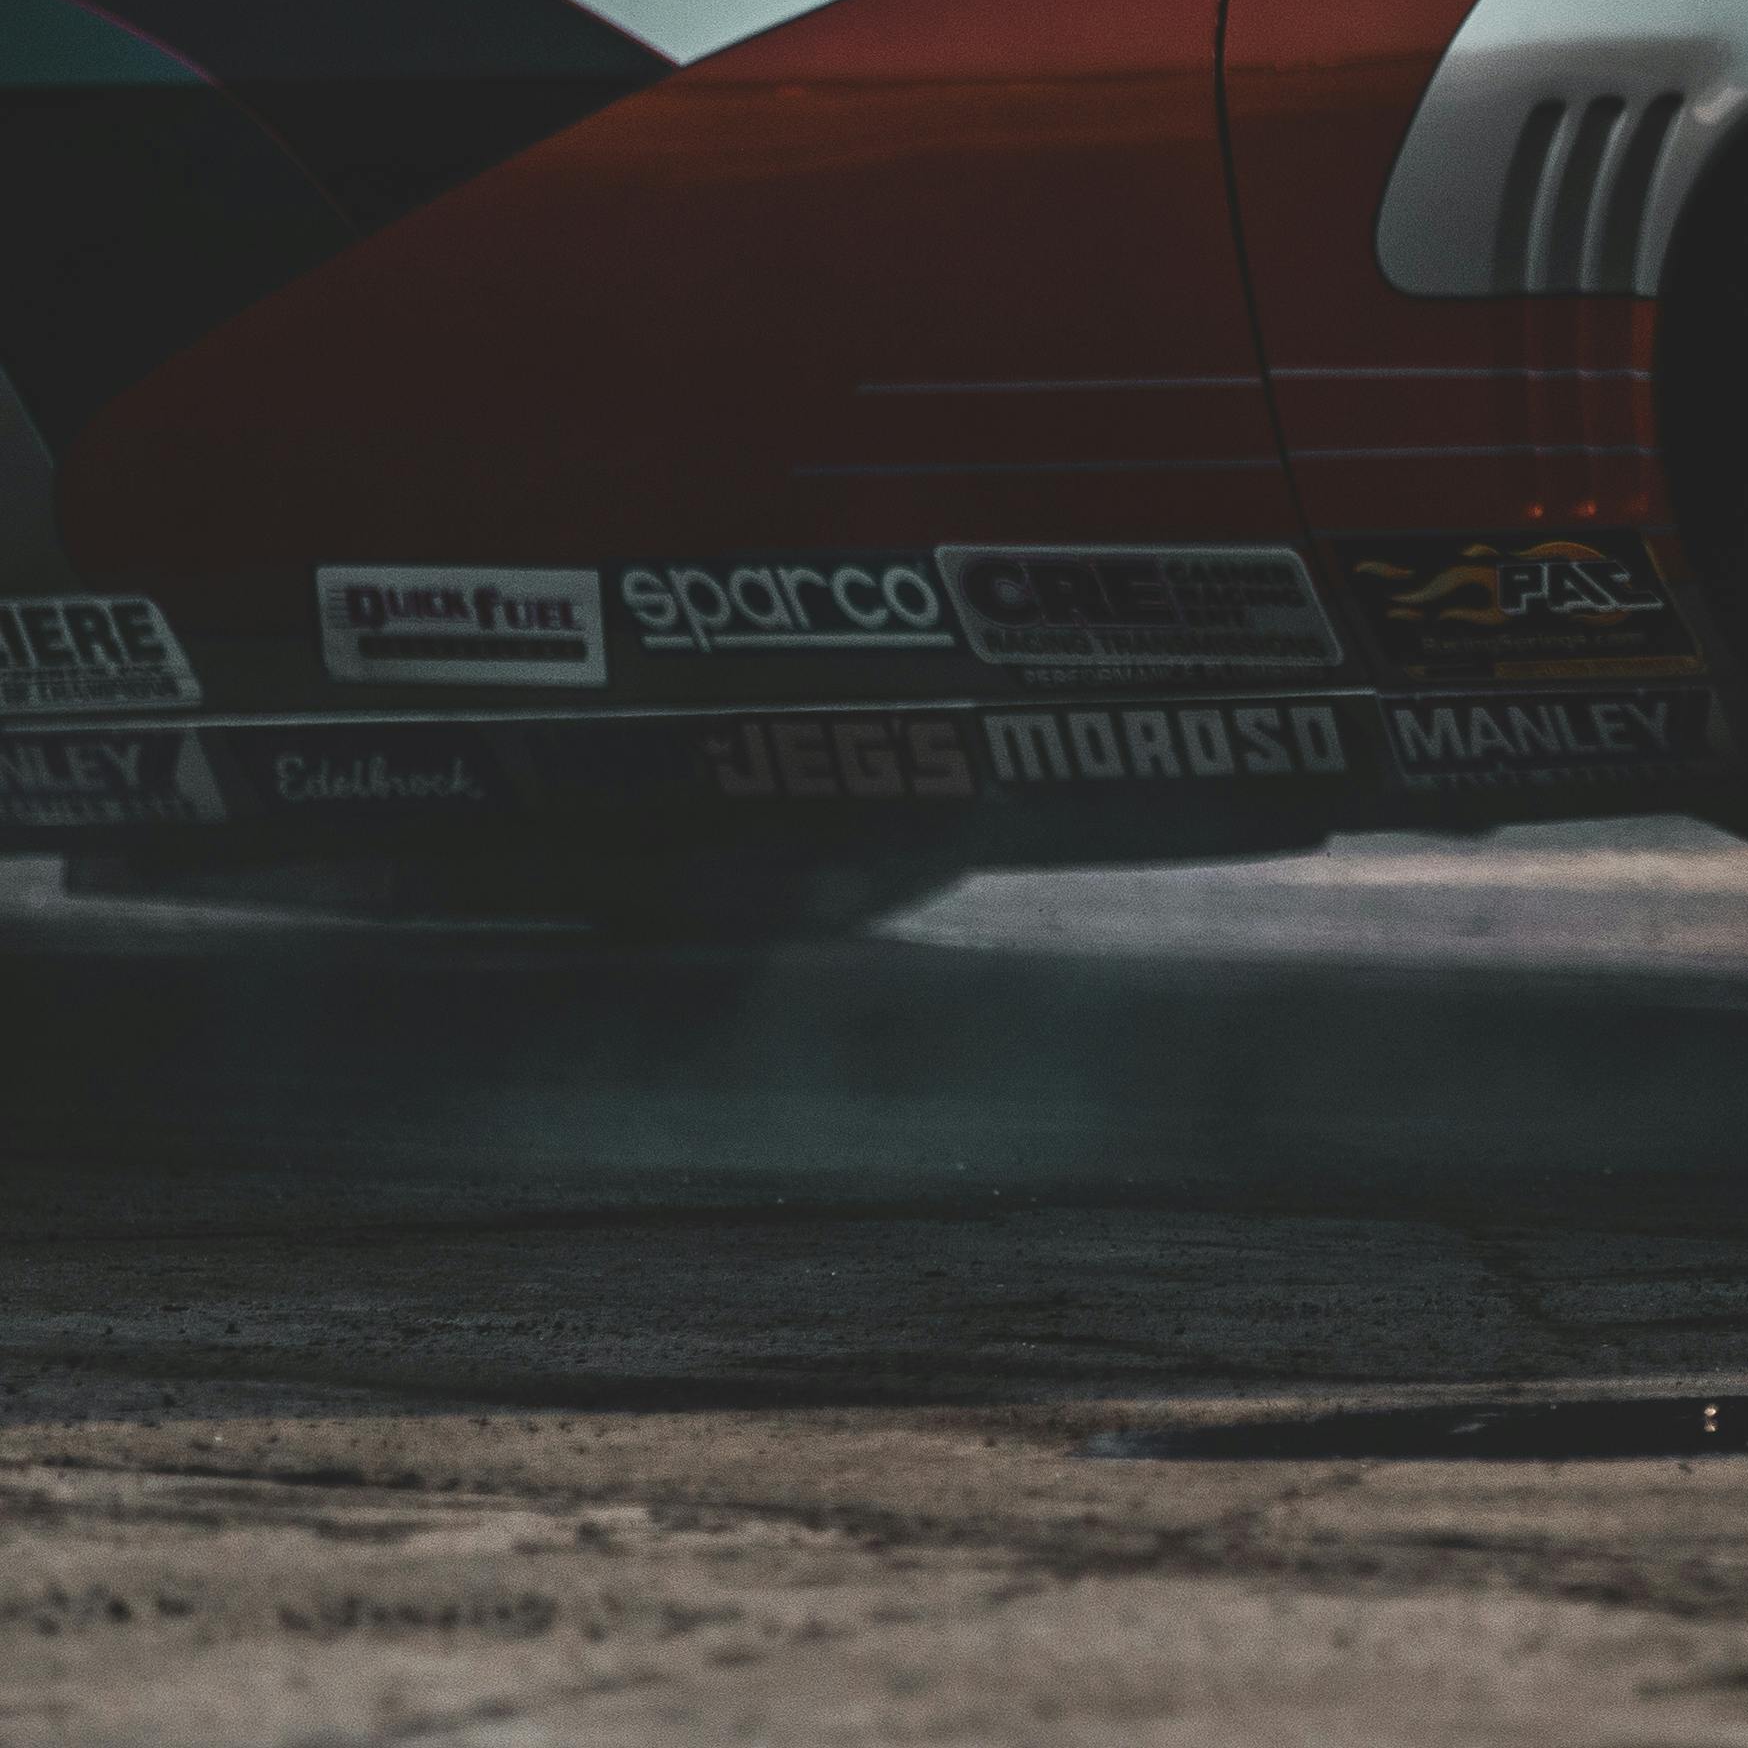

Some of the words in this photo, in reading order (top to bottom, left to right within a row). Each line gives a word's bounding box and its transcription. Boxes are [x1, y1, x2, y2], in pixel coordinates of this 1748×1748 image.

[0, 603, 167, 665] IERE
[620, 564, 941, 653] sparco
[1393, 701, 1672, 760] MANLEY
